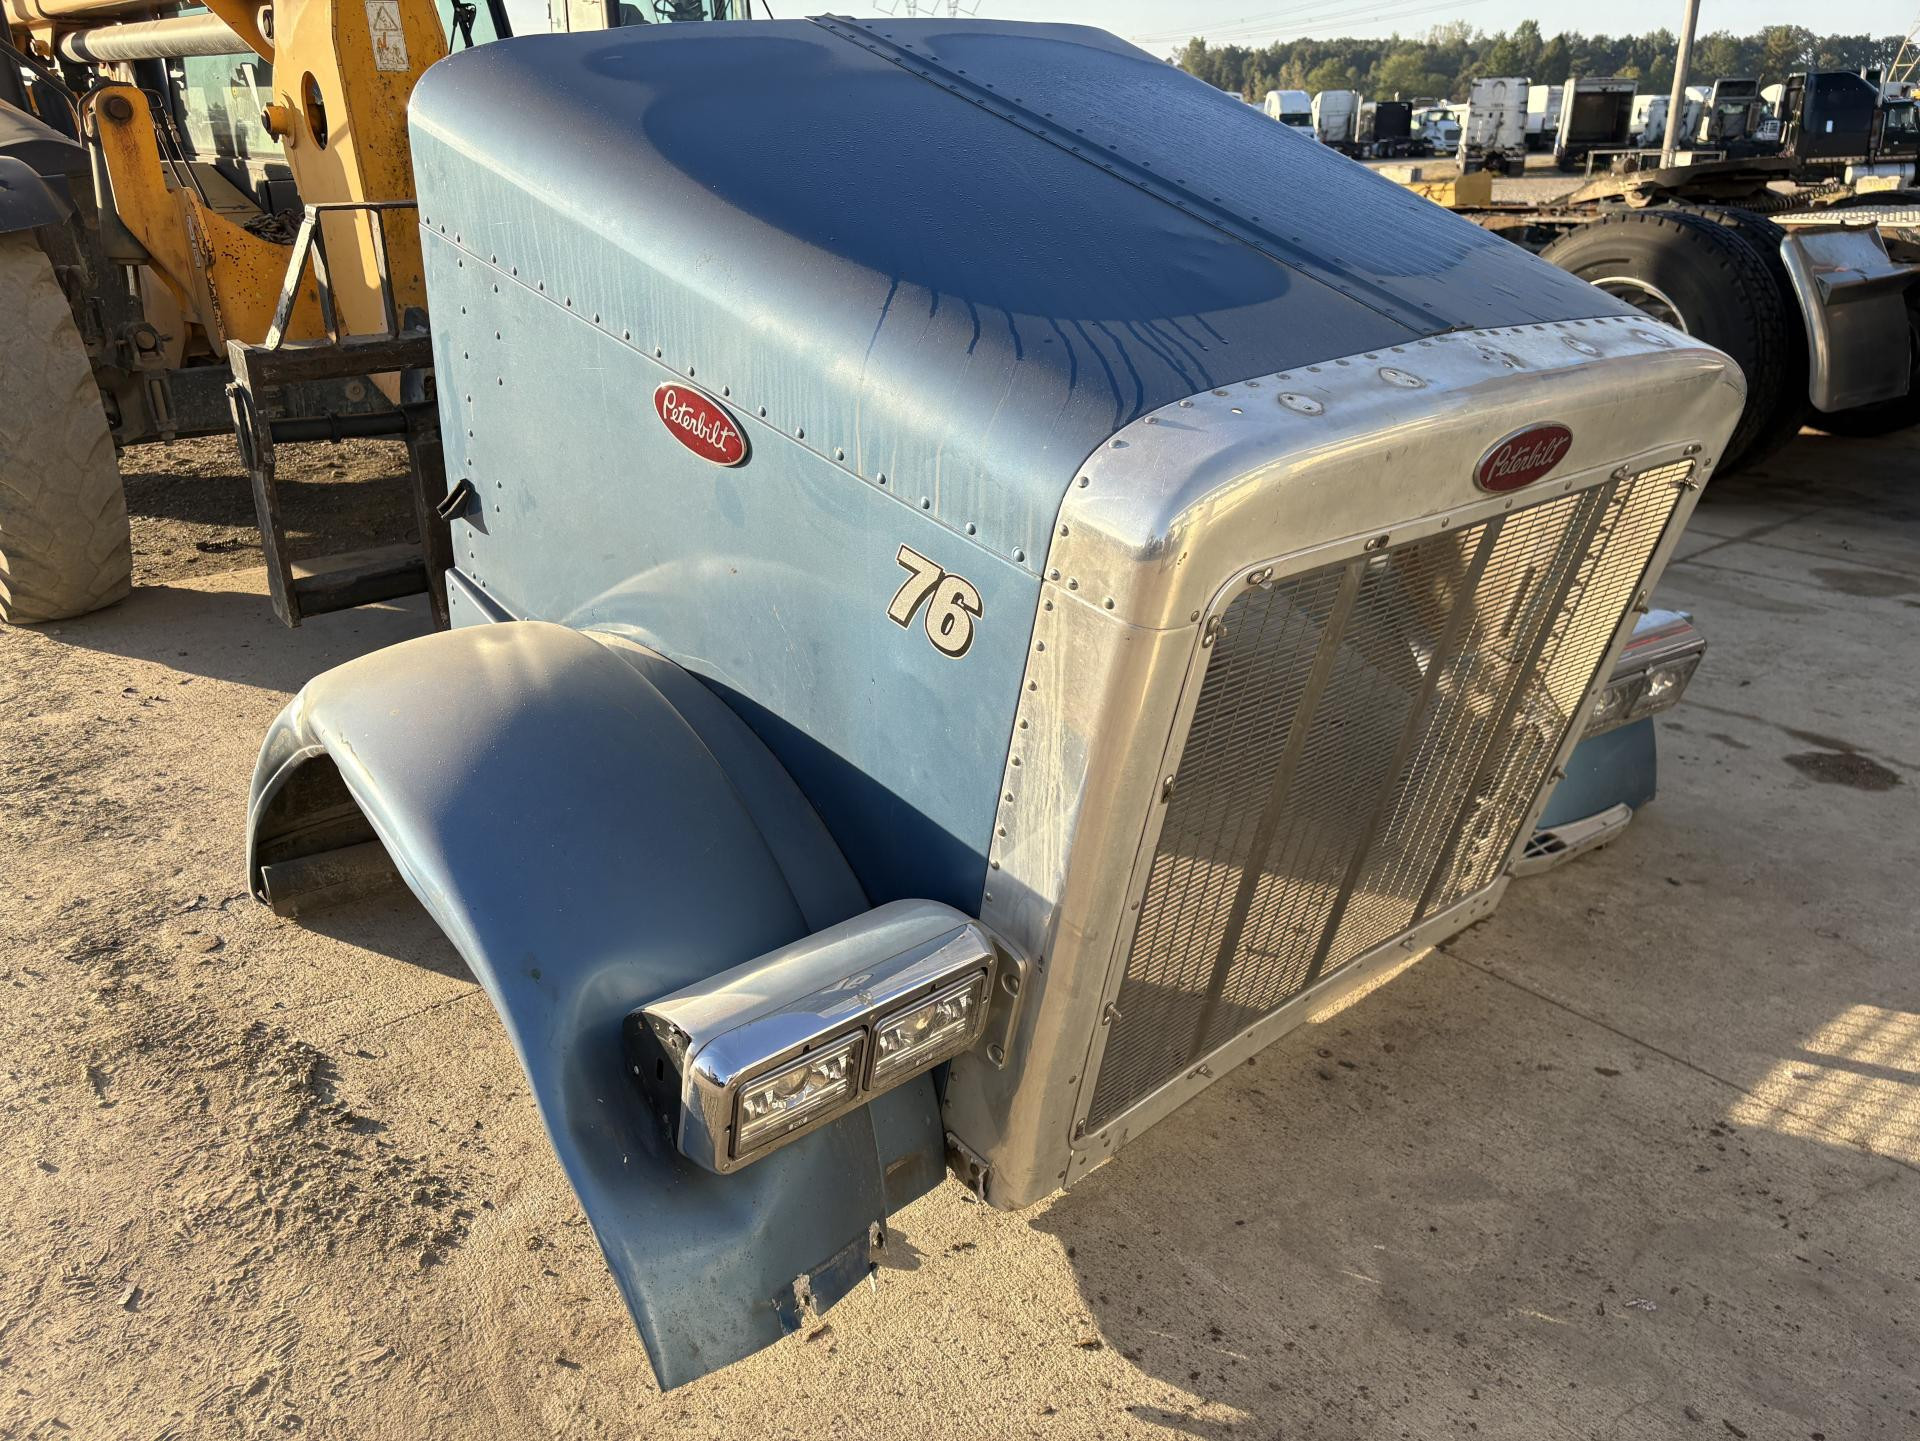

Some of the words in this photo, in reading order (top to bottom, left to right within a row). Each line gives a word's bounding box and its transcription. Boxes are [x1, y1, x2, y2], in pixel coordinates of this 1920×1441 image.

[663, 390, 735, 452] Peterbilt
[1486, 437, 1569, 482] Peterbilt
[886, 543, 984, 660] 76
